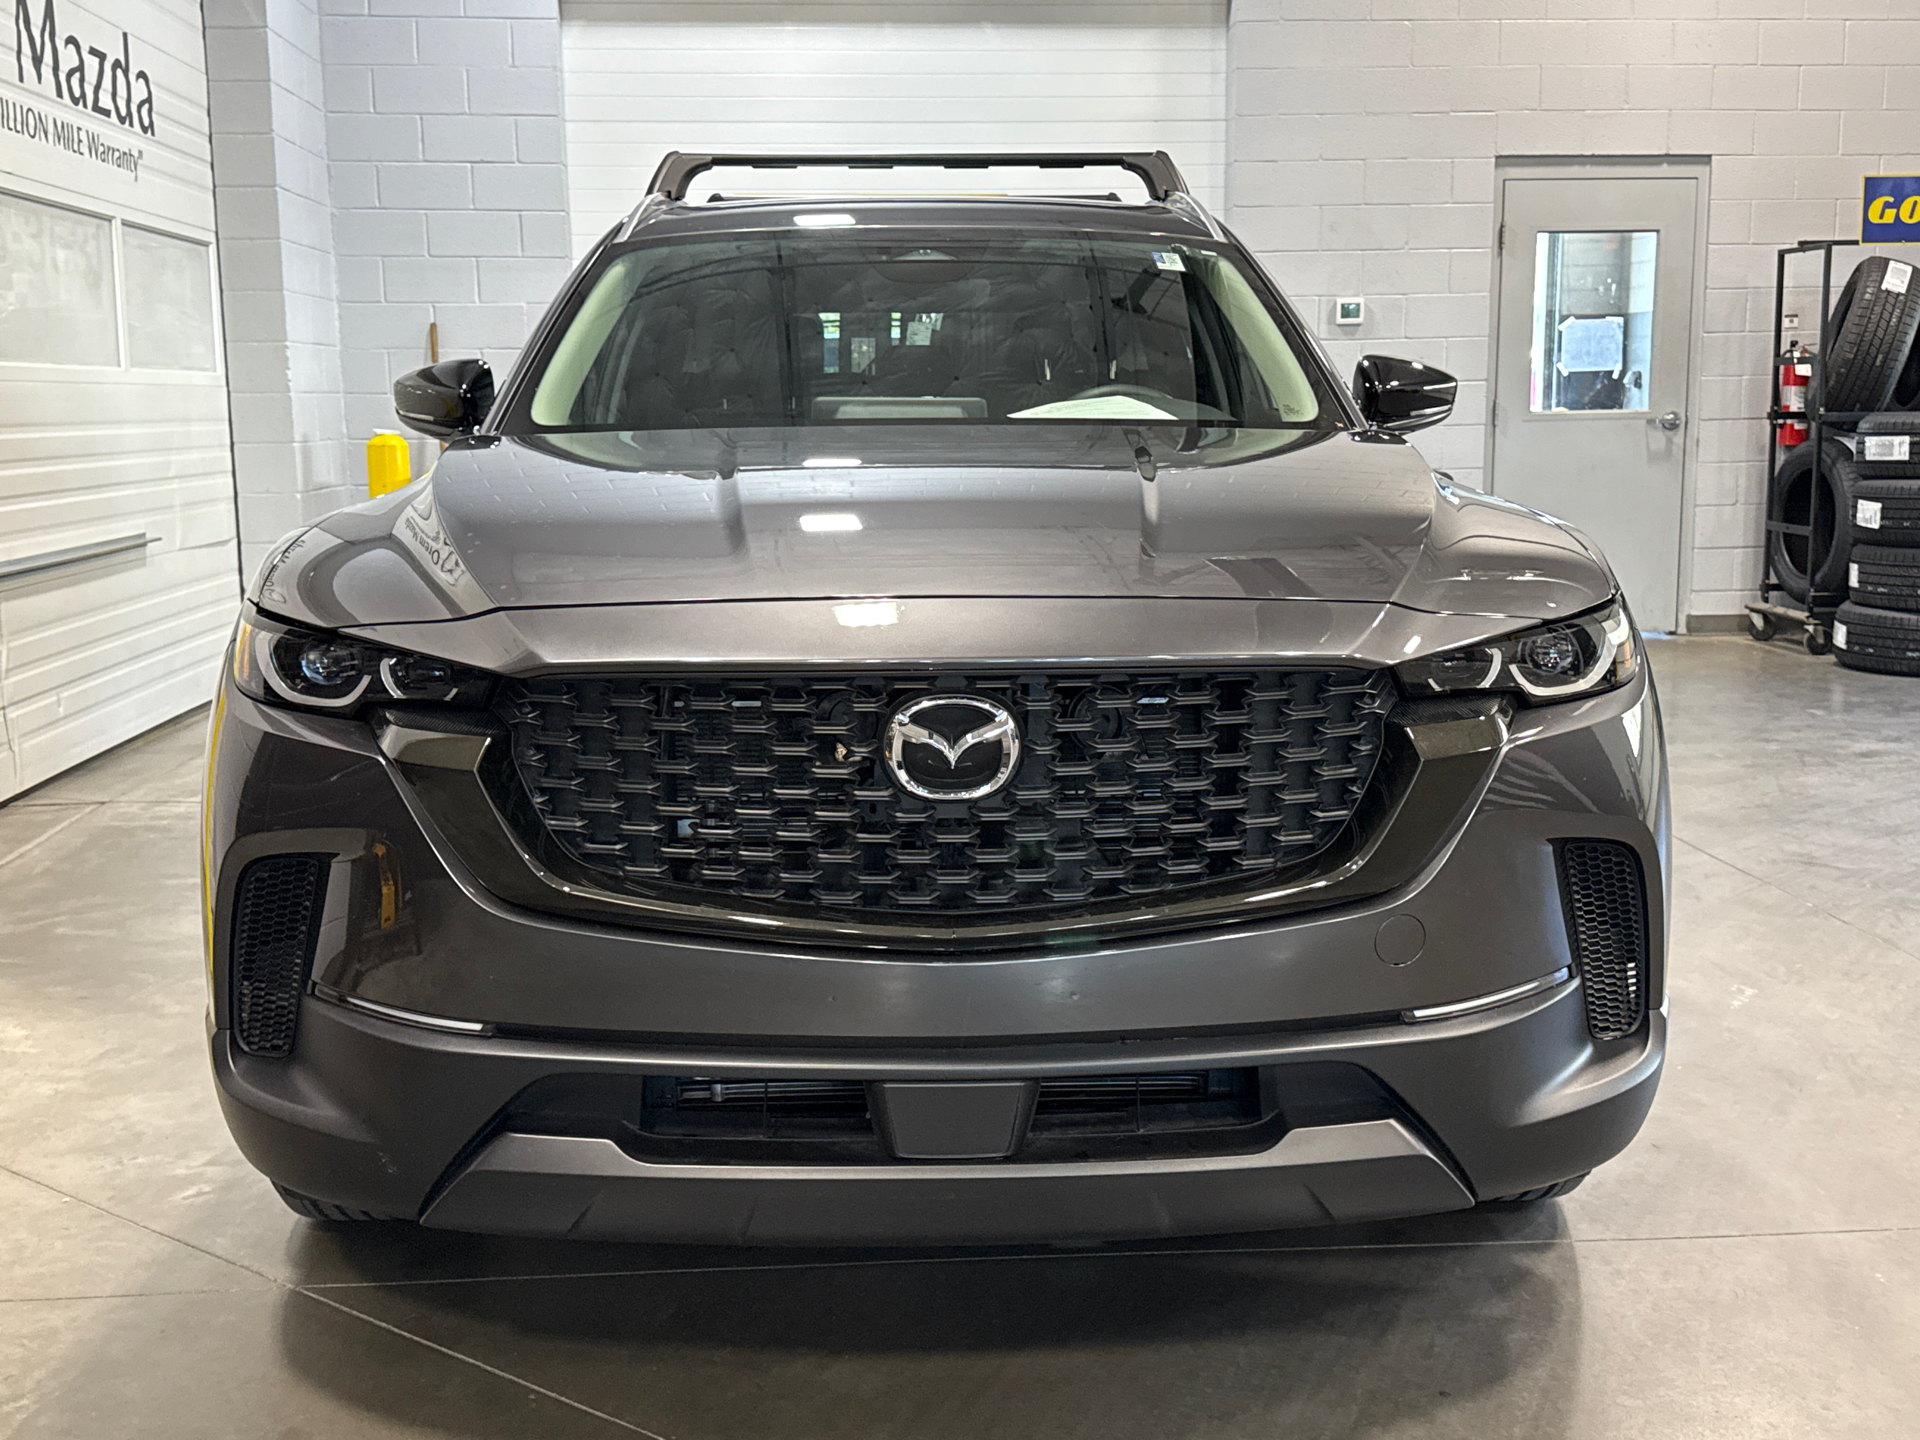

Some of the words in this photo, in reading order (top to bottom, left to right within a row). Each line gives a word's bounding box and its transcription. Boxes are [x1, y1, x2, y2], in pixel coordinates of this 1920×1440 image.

[15, 0, 156, 137] Mazda
[52, 117, 84, 156] MILE
[1868, 195, 1920, 224] GO
